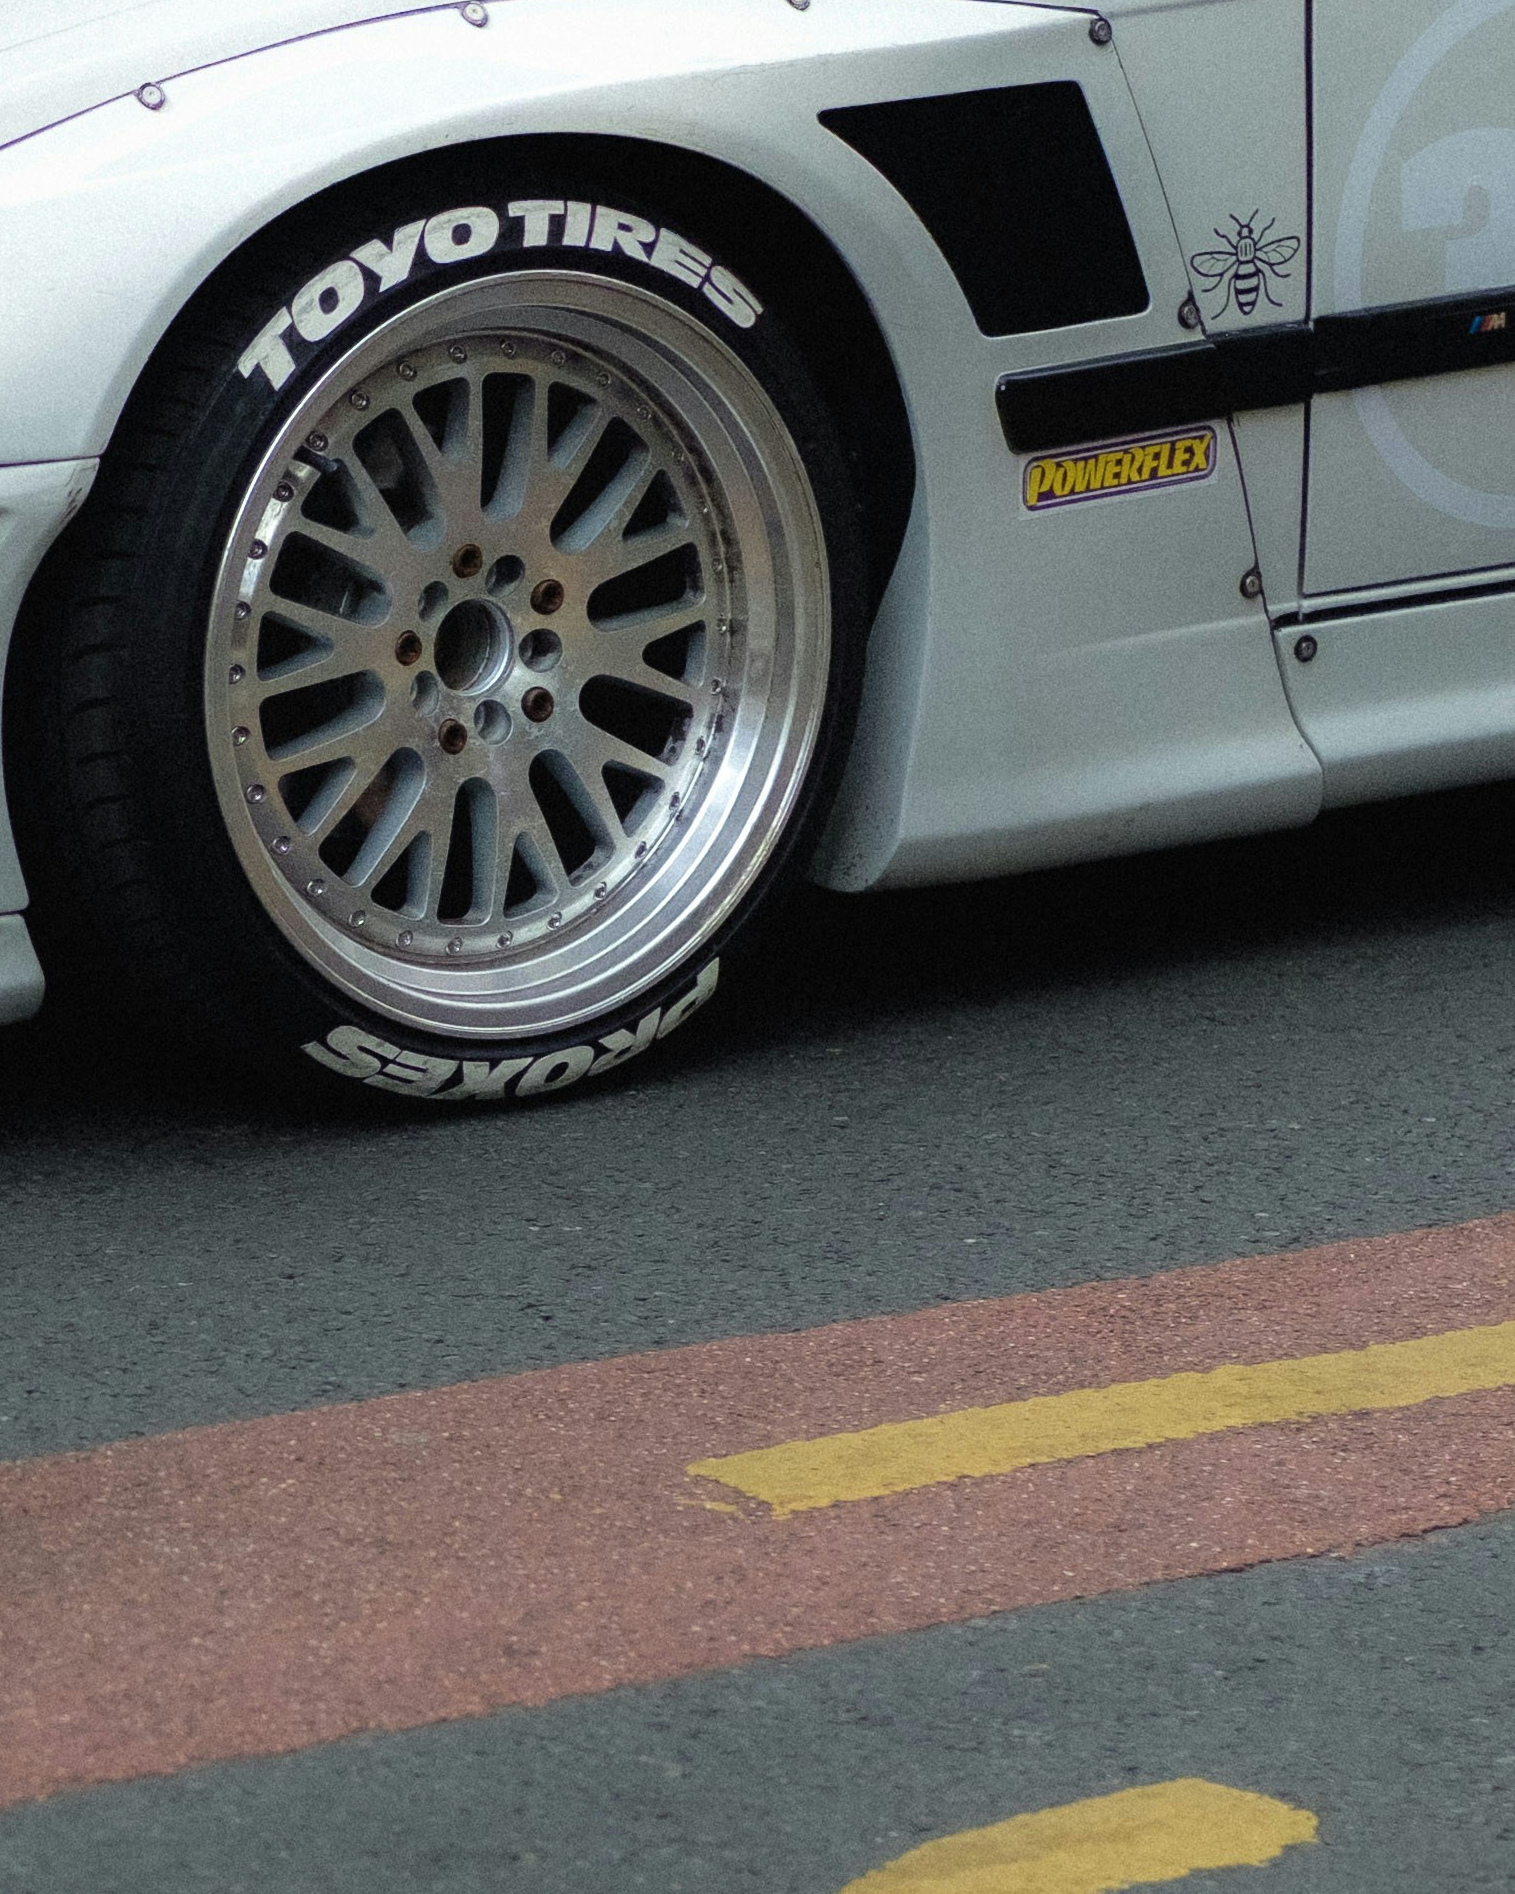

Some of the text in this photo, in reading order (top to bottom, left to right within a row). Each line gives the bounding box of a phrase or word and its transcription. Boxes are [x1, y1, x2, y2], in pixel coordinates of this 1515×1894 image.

[237, 199, 763, 392] TOYO TIRES
[1026, 433, 1214, 506] POWERFLEX
[300, 957, 720, 1100] PROXES
